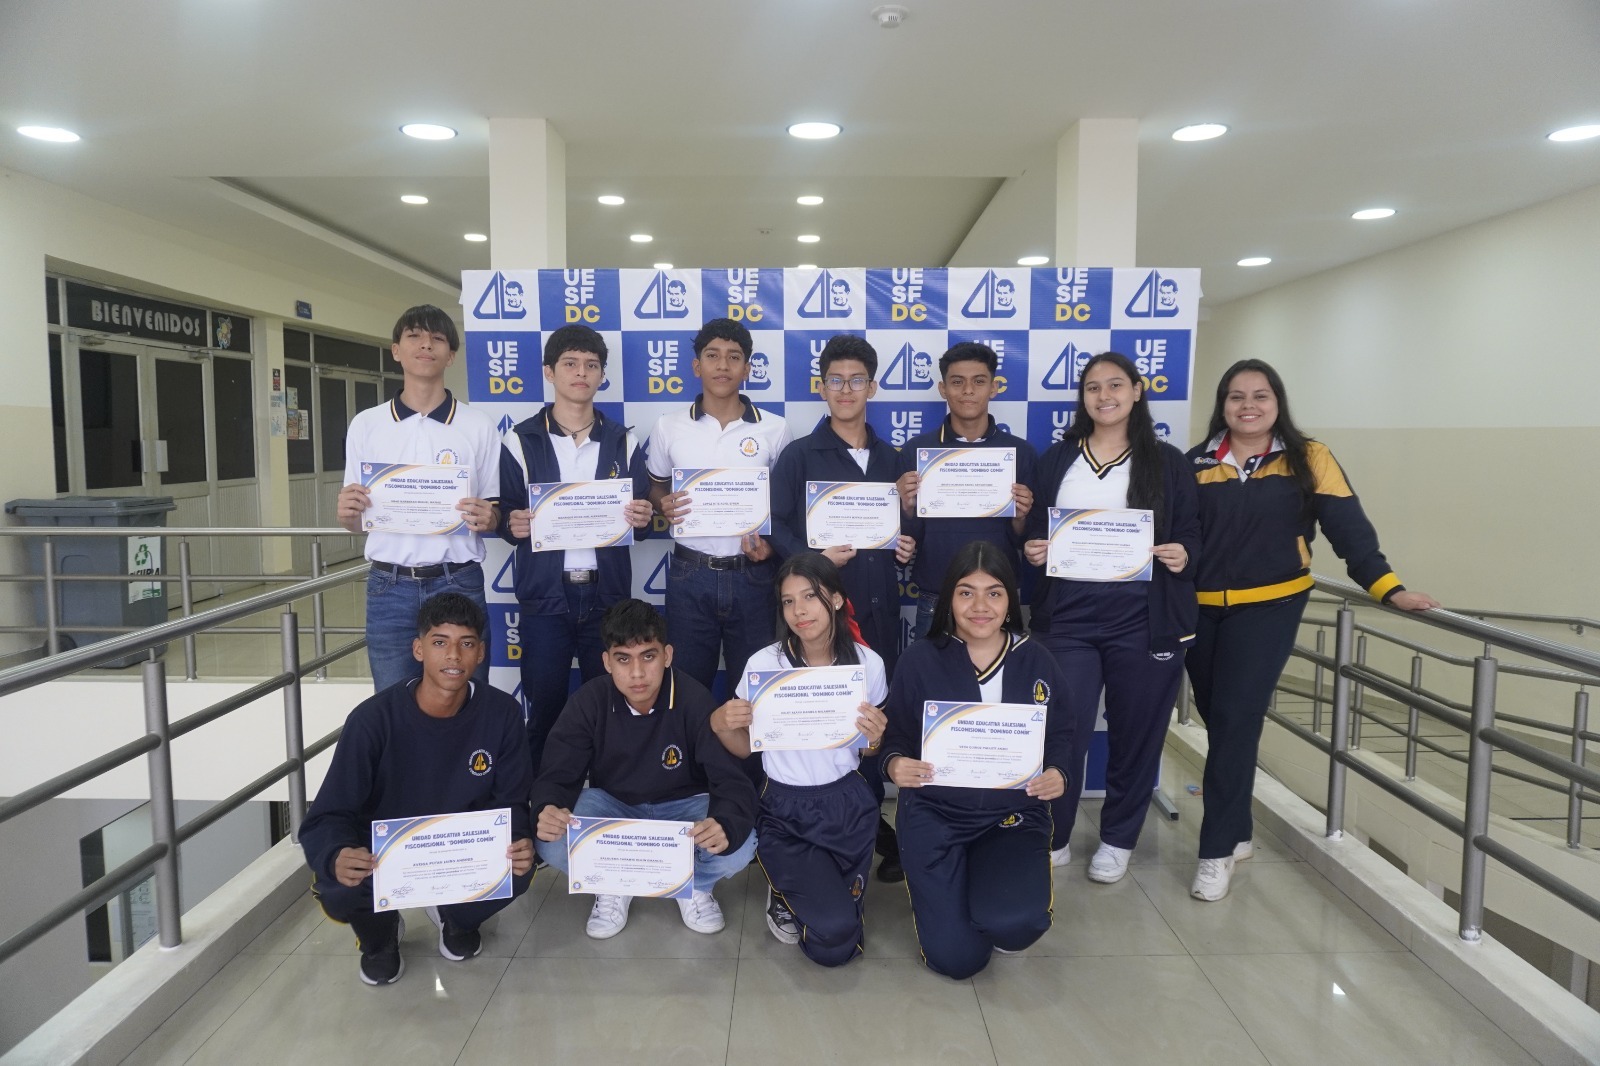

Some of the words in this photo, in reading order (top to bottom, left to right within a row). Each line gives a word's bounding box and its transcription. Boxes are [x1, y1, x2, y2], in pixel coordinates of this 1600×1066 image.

[564, 269, 595, 285] UE
[728, 268, 759, 285] UE
[892, 268, 923, 284] UE
[1056, 268, 1088, 284] UE
[565, 286, 594, 304] SF
[728, 286, 757, 303] SF
[892, 285, 922, 303] SF
[1056, 285, 1085, 303] SF
[92, 300, 200, 337] BIENVENIDOS
[566, 306, 600, 323] DC
[728, 304, 763, 322] DC
[892, 304, 927, 322] DC
[1056, 304, 1091, 322] DC
[488, 341, 518, 358] UE
[647, 341, 678, 358] UE
[811, 340, 830, 357] U
[974, 340, 1004, 357] E
[1136, 339, 1166, 356] UE
[489, 359, 516, 376] SF
[648, 359, 676, 376] SF
[811, 358, 821, 375] S
[1136, 358, 1164, 374] SF
[490, 377, 523, 394] DC
[649, 376, 683, 394] DC
[892, 412, 922, 428] UE
[1052, 429, 1065, 444] S
[505, 612, 519, 627] U
[507, 629, 520, 644] S
[508, 645, 522, 659] D
[405, 841, 445, 850] FISCOMISIONAL
